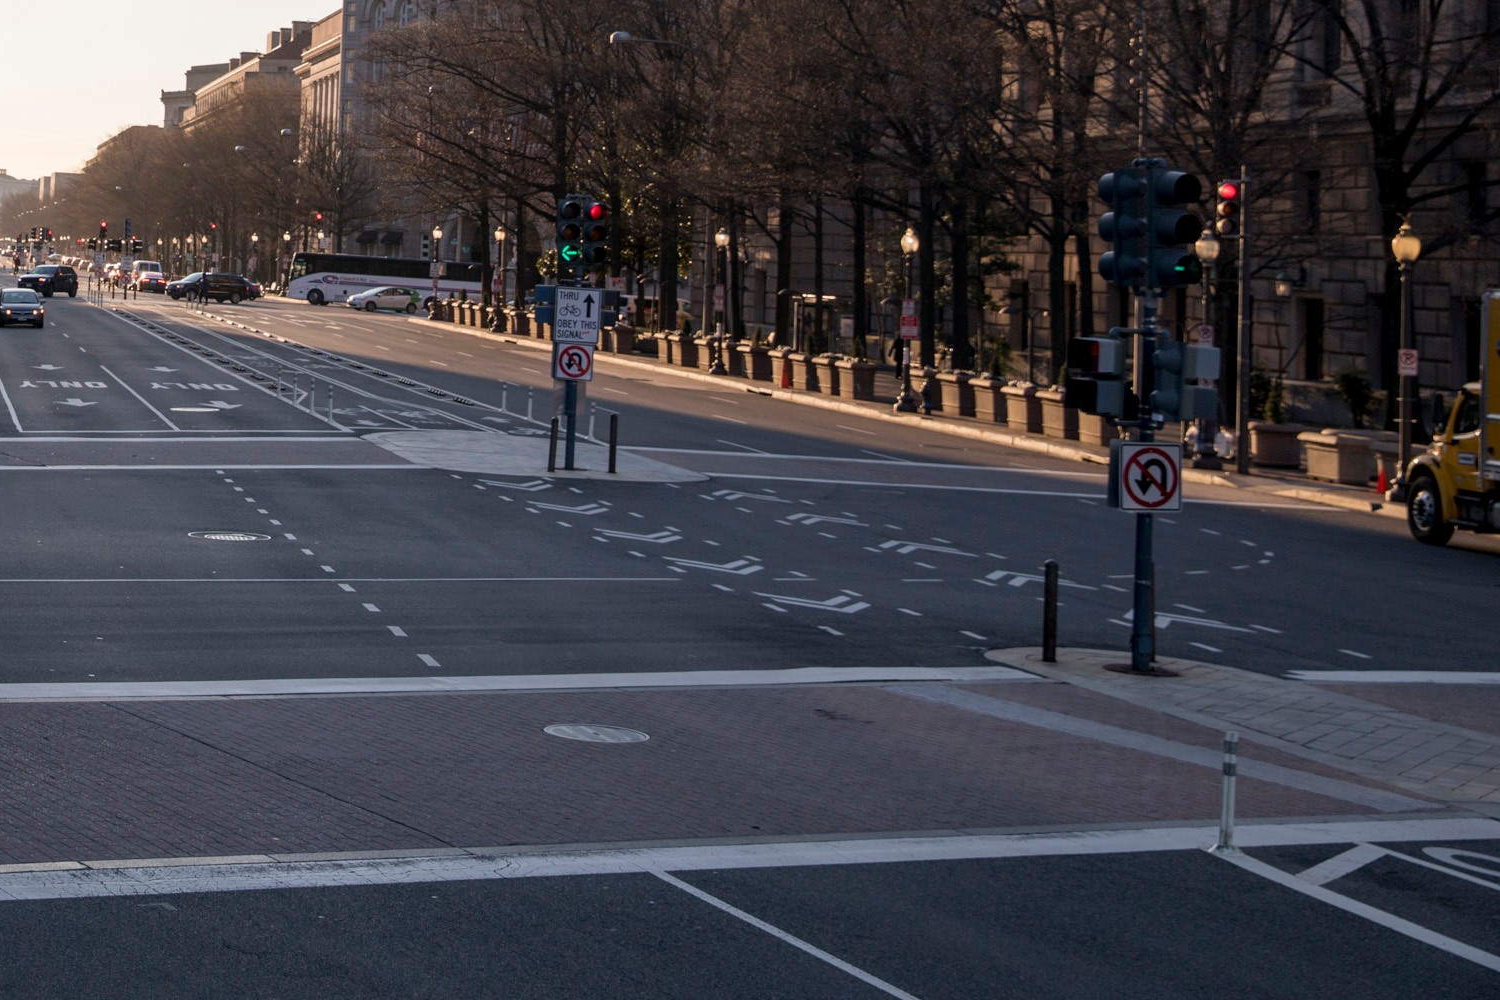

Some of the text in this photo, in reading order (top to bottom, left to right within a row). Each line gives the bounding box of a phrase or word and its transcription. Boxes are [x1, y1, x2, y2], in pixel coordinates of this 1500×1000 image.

[559, 291, 579, 301] THRU
[557, 319, 597, 330] OBEY THIS
[557, 329, 584, 339] SIGNAL
[19, 380, 109, 389] ONLY
[150, 382, 240, 391] ONLY
